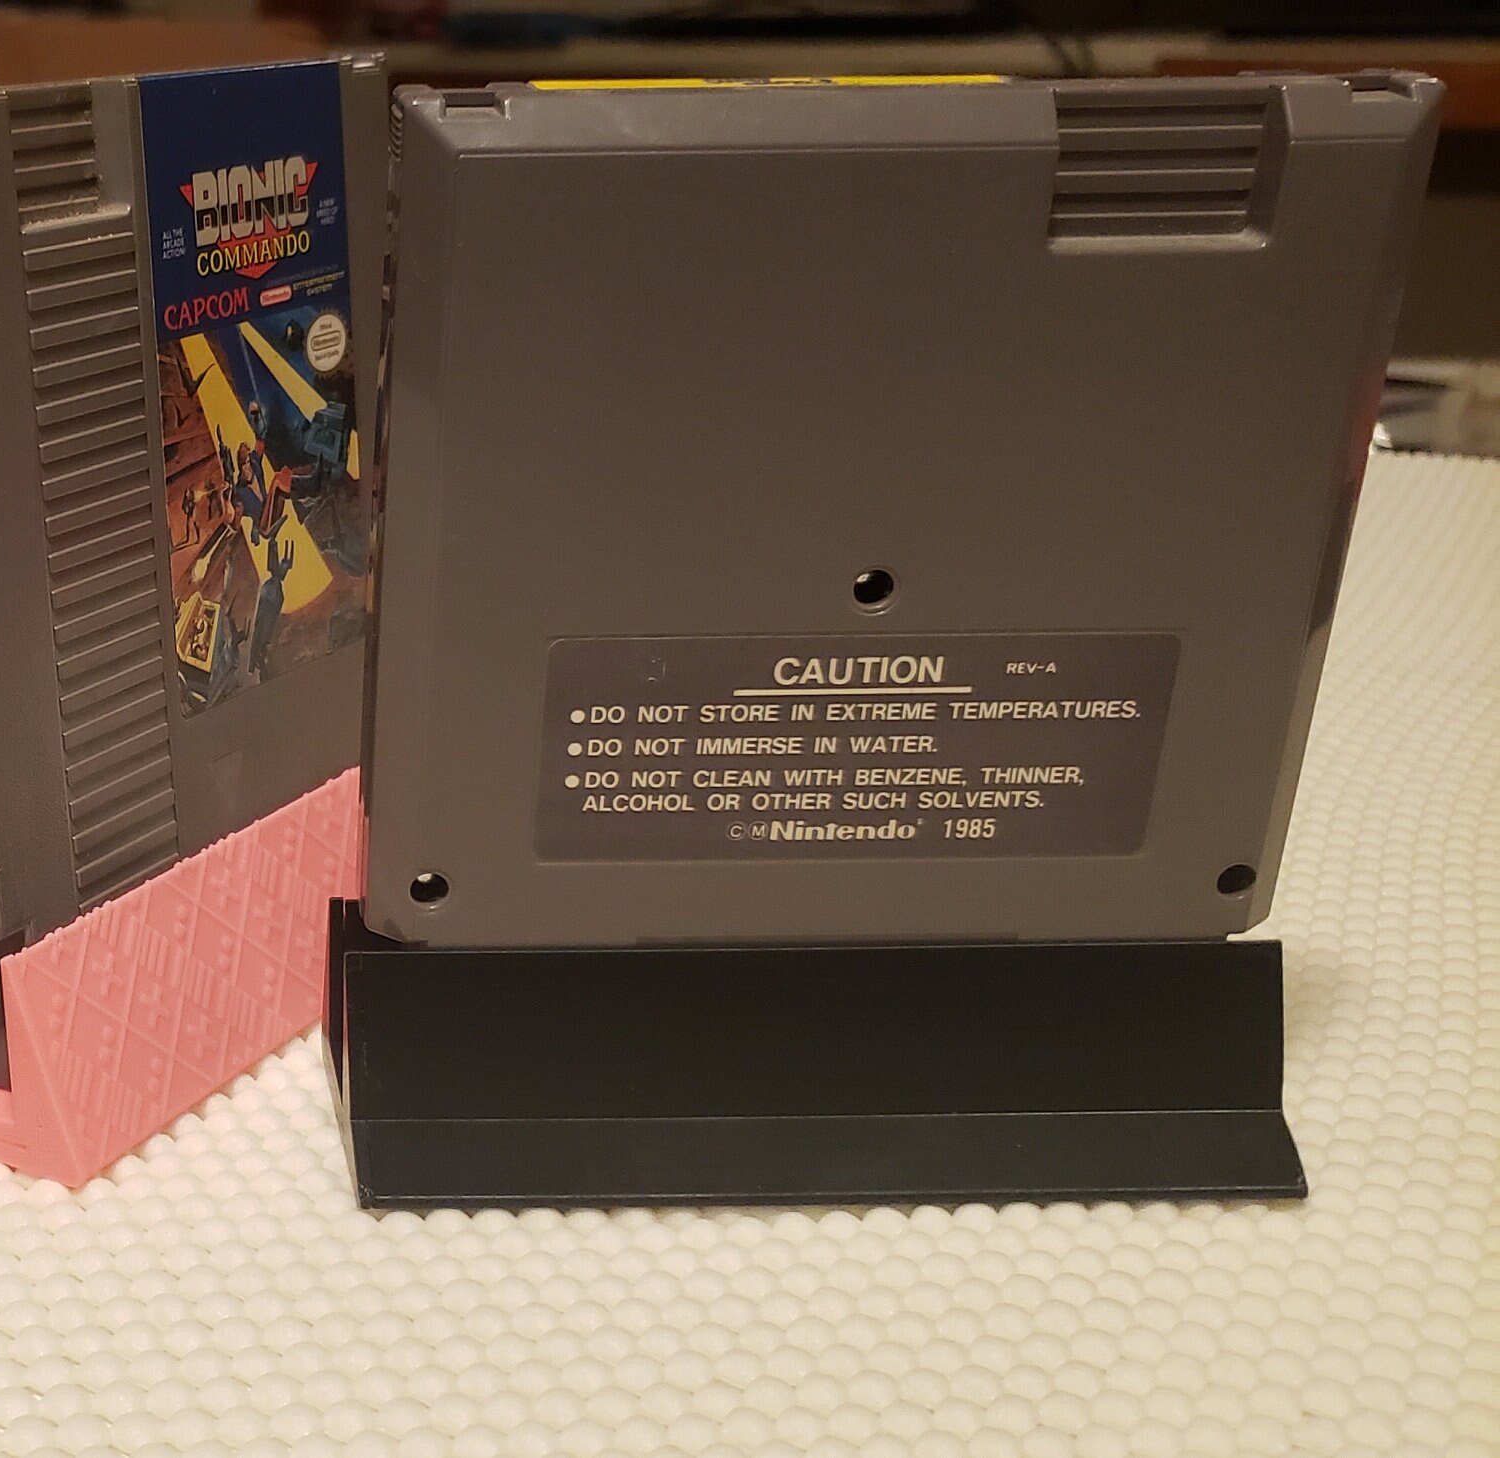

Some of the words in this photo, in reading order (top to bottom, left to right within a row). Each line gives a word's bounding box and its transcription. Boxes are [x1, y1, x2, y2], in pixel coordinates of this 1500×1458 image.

[191, 156, 309, 248] BIONIC
[196, 230, 311, 277] COMMANDO
[163, 286, 250, 330] CAPCOM
[773, 656, 944, 686] CAUTION
[1006, 661, 1057, 674] REV-A
[590, 706, 626, 724] DO
[637, 705, 689, 723] NOT
[699, 704, 781, 723] STORE
[791, 704, 814, 721] IN
[826, 702, 937, 721] EXTREME
[949, 700, 1141, 720] TEMPERATURES.
[587, 738, 622, 756] DO
[634, 738, 686, 756] NOT
[696, 737, 804, 755] IMMERSE
[813, 736, 837, 754] IN
[849, 735, 938, 753] WATER.
[584, 771, 620, 789] DO
[631, 770, 682, 788] NOT
[692, 770, 772, 788] CLEAN
[784, 768, 843, 787] WITH
[854, 767, 967, 787] BENZENE,
[980, 766, 1085, 787] THINNER,
[581, 794, 695, 812] ALCOHOL
[706, 793, 740, 811] OR
[751, 793, 832, 811] OTHER
[842, 792, 907, 810] SUCH
[917, 791, 1045, 810] SOLVENTS.
[943, 818, 997, 839] 1985
